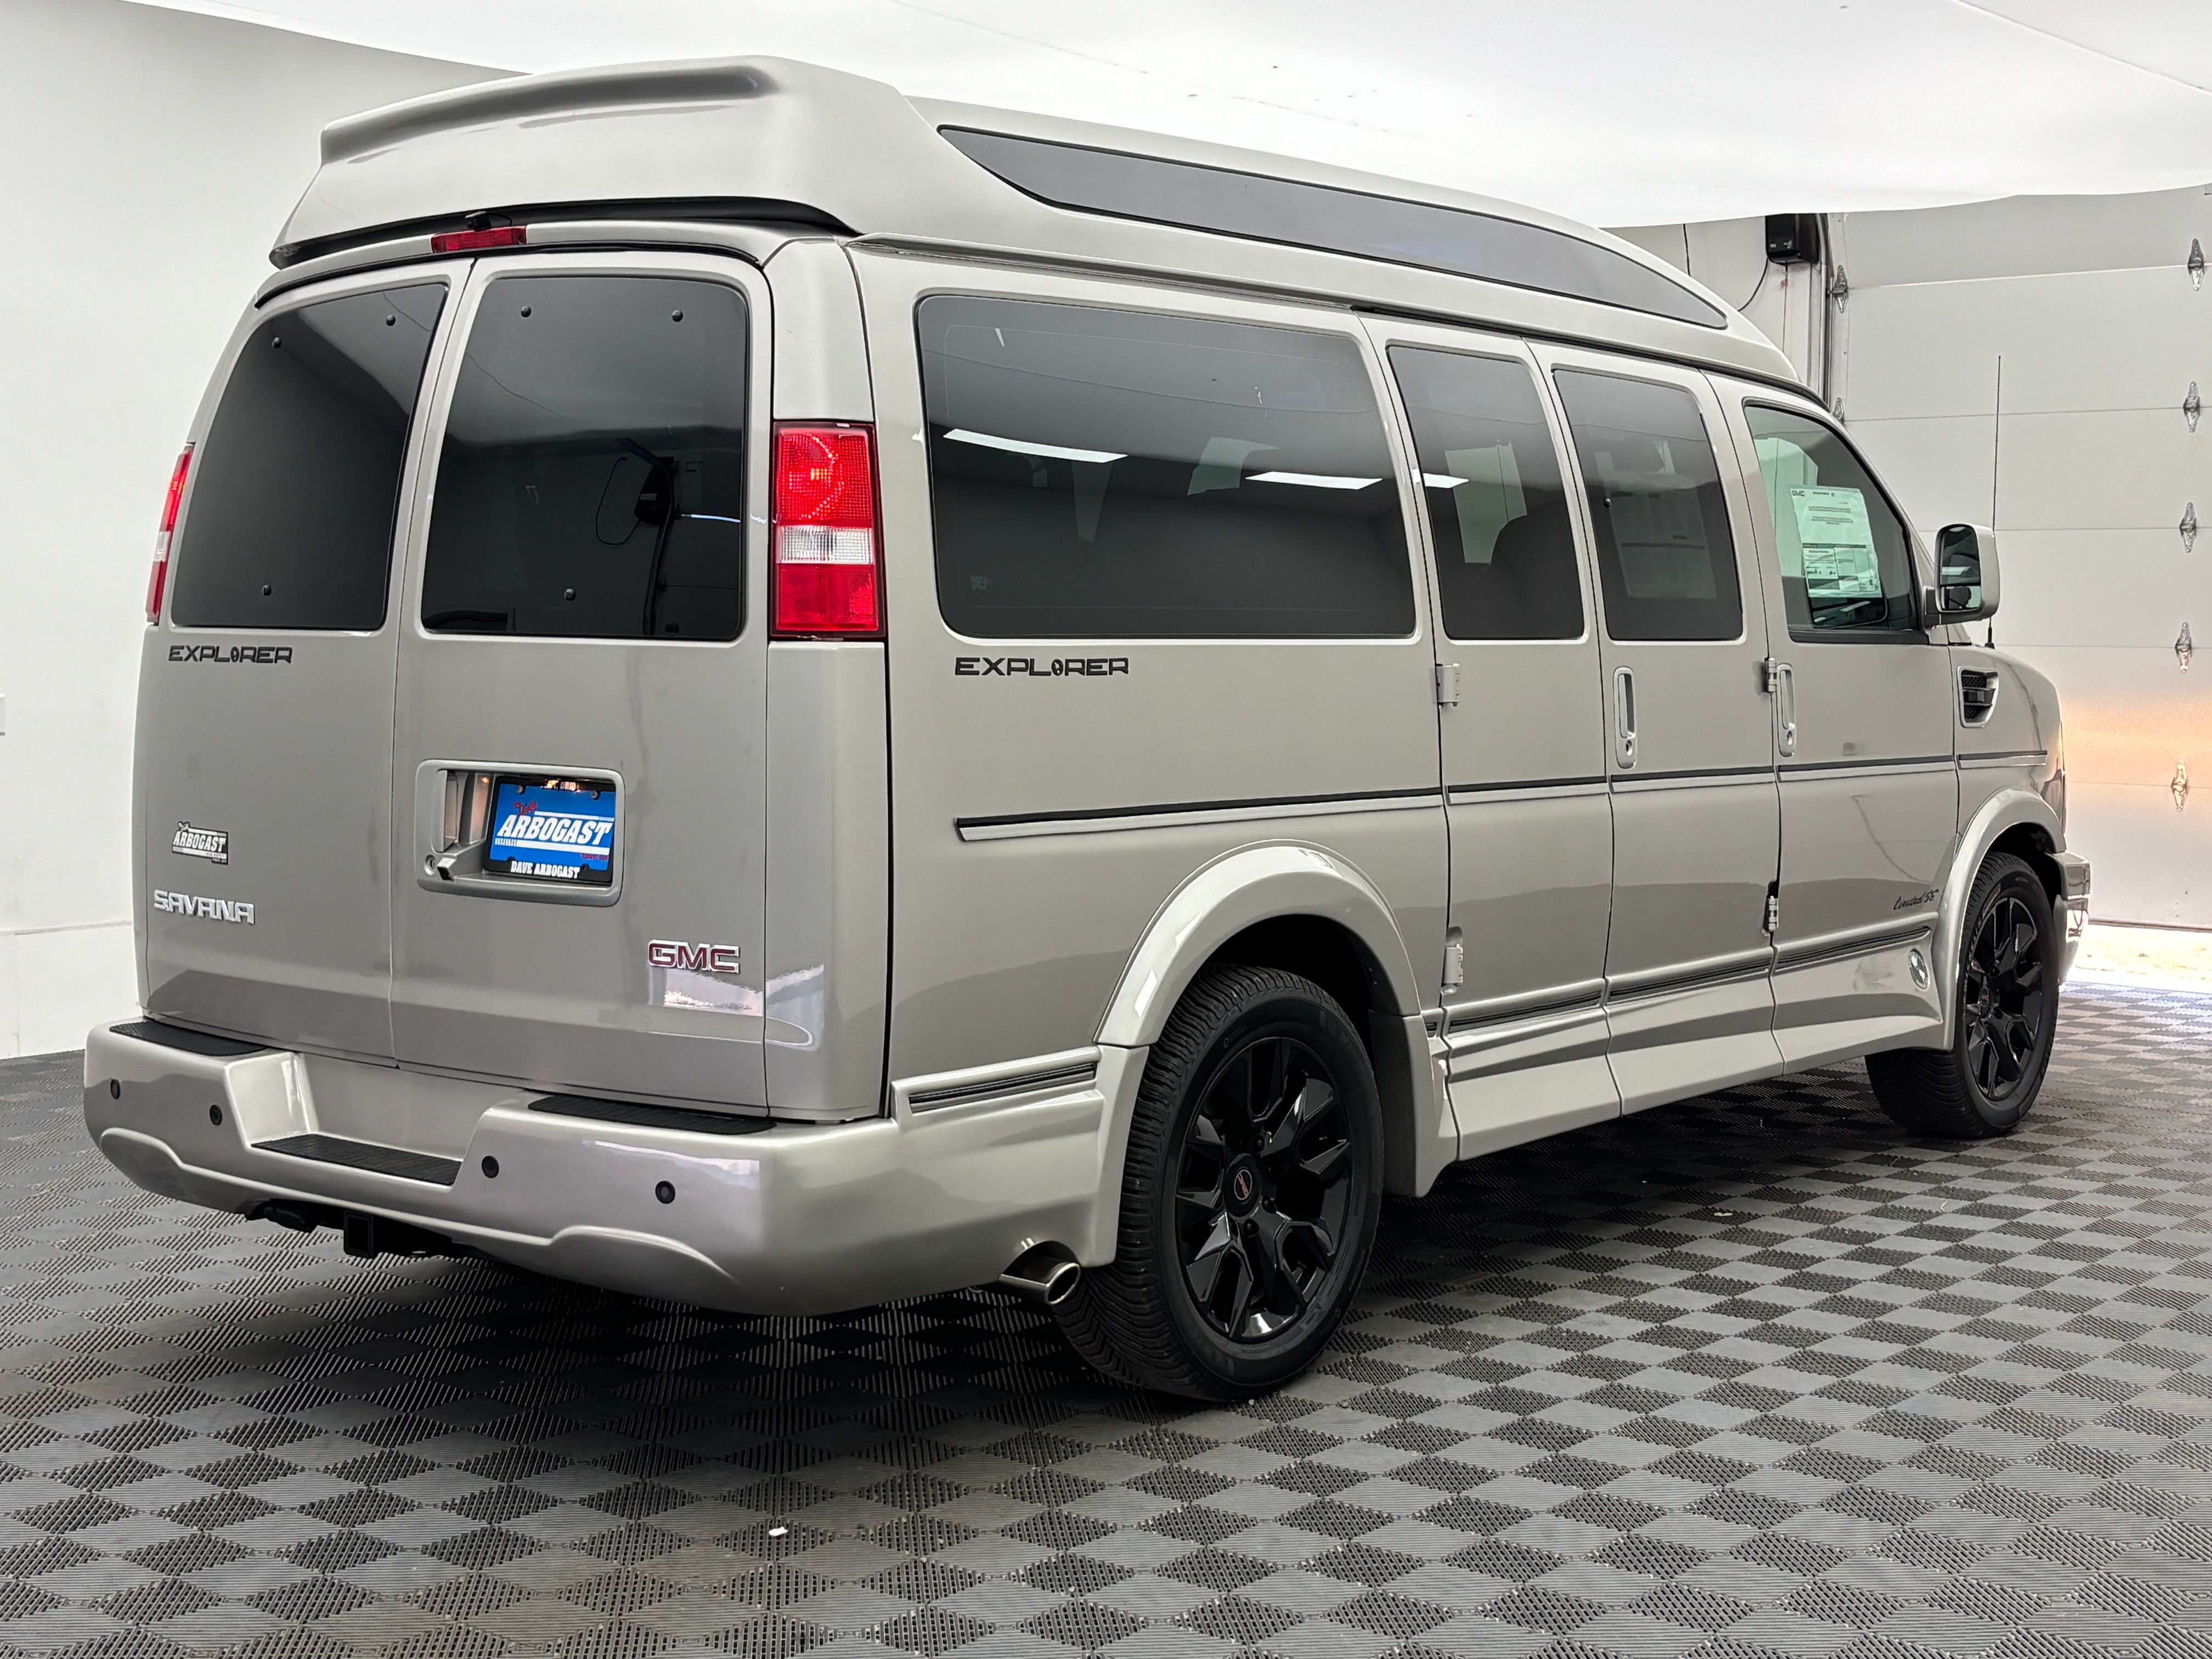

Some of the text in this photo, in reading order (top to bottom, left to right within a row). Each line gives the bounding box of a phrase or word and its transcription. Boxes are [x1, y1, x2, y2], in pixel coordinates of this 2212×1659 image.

[168, 645, 292, 664] EXPLORER
[955, 657, 1128, 676] EXPLORER
[497, 815, 613, 845] ARBOGAST
[173, 831, 227, 852] ARBOGAST
[510, 860, 580, 879] DAVE ARBOGAST
[154, 889, 255, 924] SAVANA
[648, 939, 740, 974] GMC
